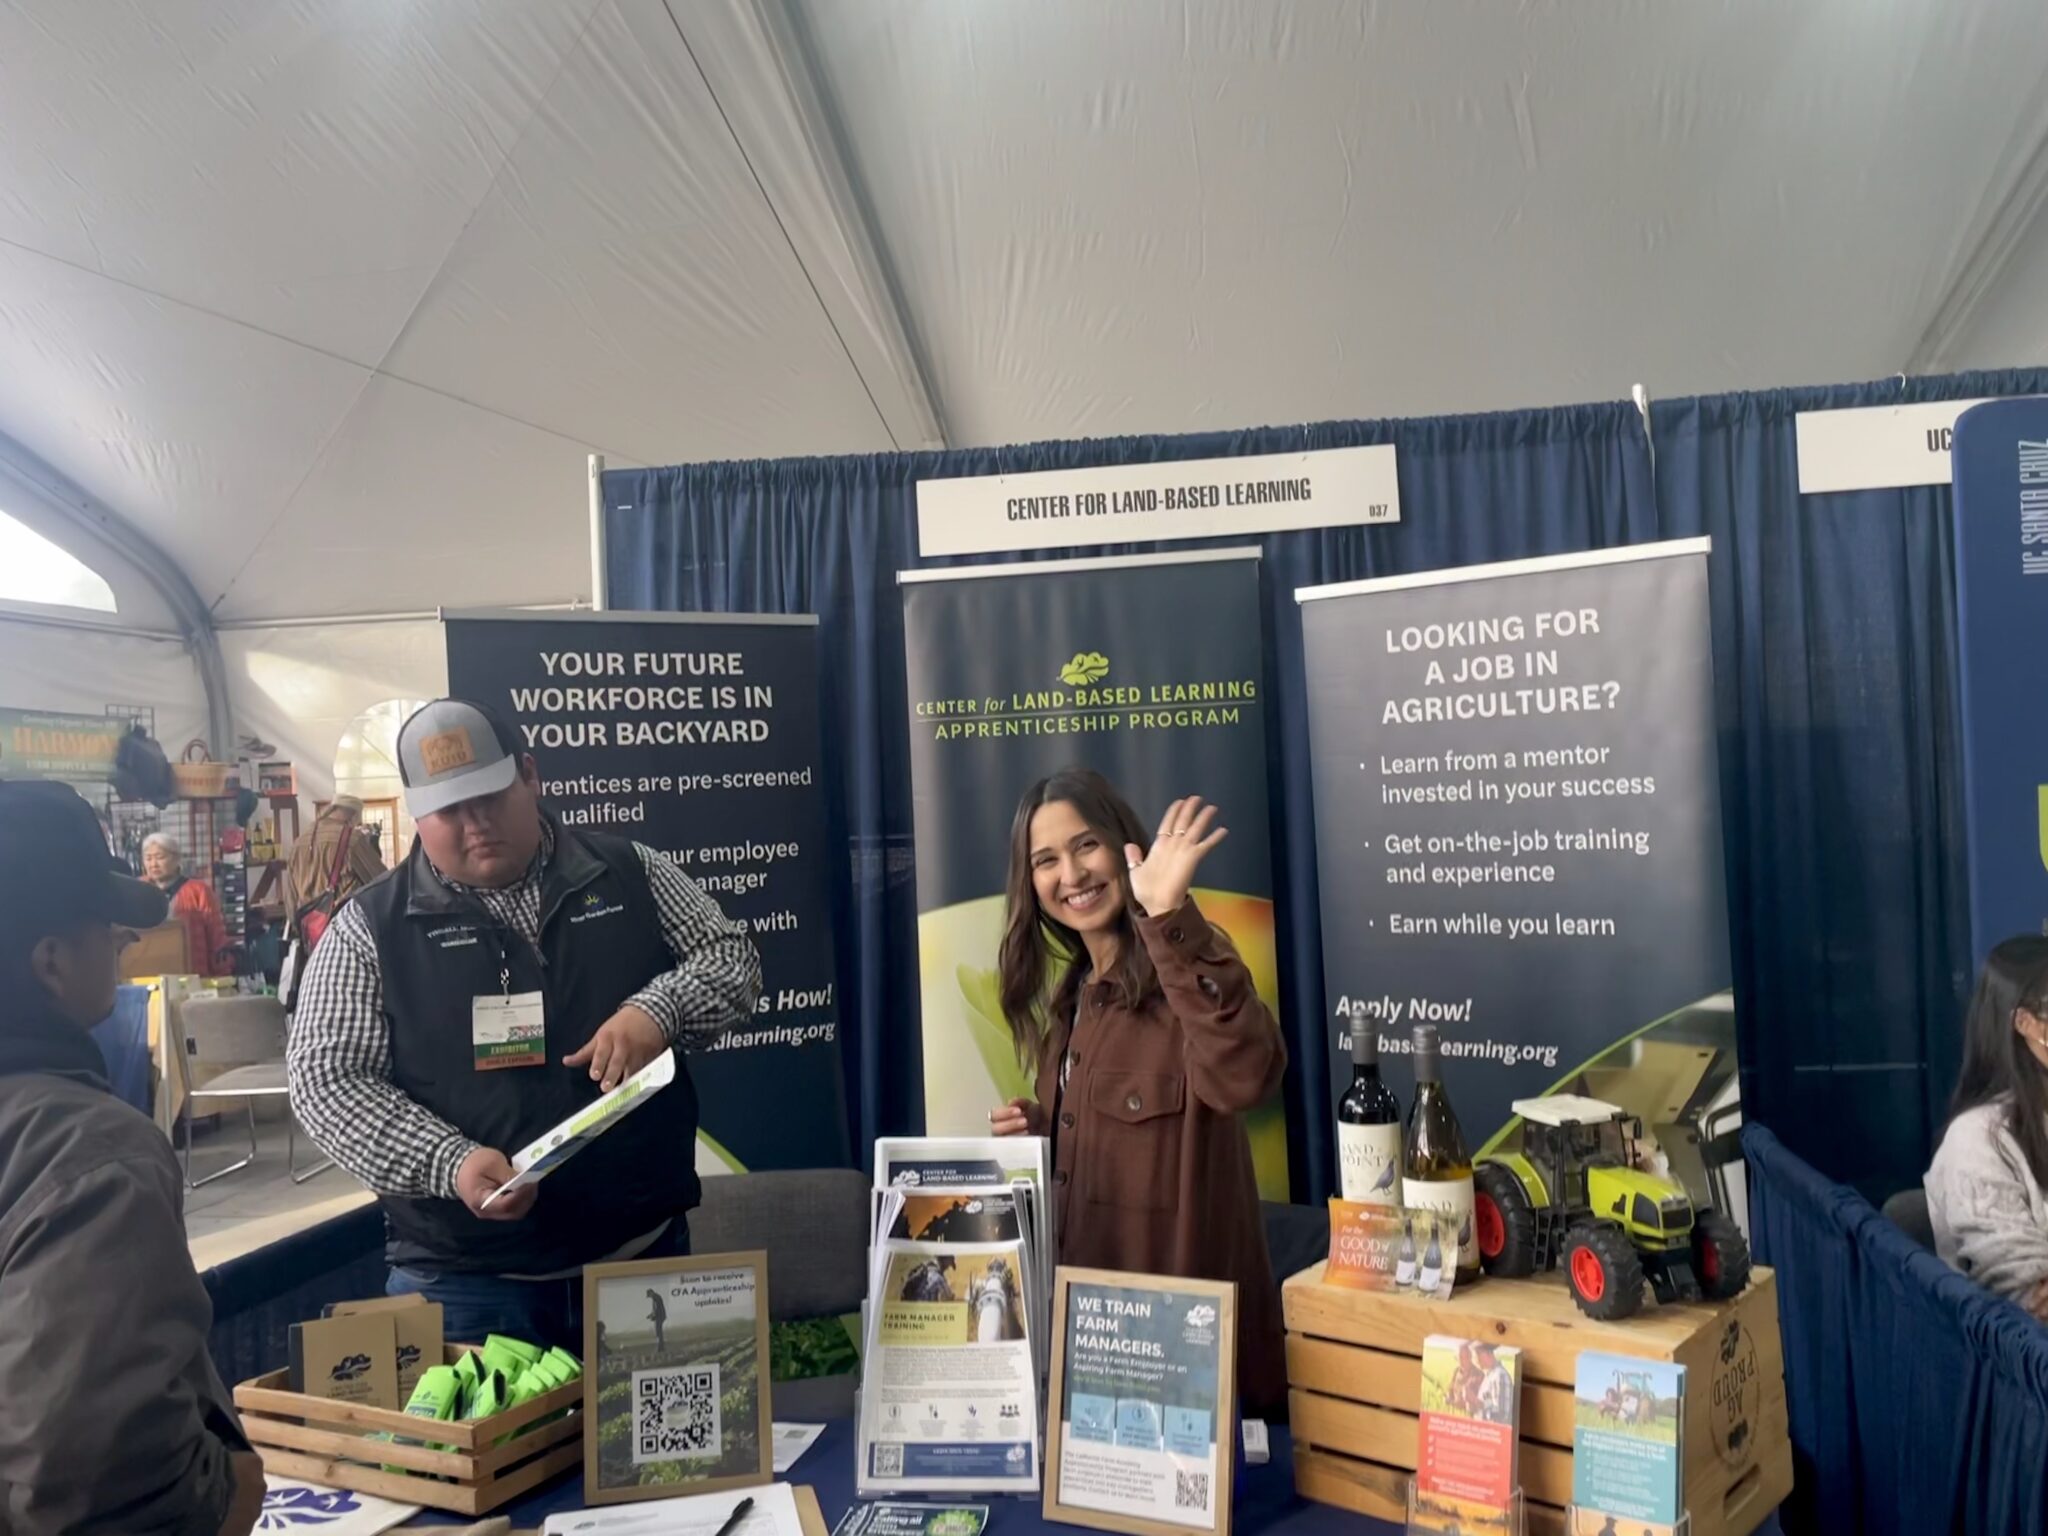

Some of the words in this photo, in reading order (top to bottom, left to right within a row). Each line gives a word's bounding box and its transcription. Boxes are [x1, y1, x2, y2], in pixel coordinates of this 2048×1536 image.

[1927, 427, 1952, 452] UC
[1007, 495, 1070, 521] CENTER
[1075, 492, 1108, 517] FOR
[1112, 485, 1220, 515] LAND-BASED
[1226, 478, 1312, 506] LEARNING
[1386, 616, 1525, 653] LOOKING
[1535, 607, 1600, 638] FOR
[540, 652, 626, 677] YOUR
[634, 652, 744, 676] FUTURE
[1424, 661, 1446, 686] A
[1452, 654, 1515, 683] JOB
[1525, 650, 1558, 677] IN
[510, 686, 704, 712] WORKFORCE
[711, 686, 737, 709] IS
[745, 685, 774, 708] IN
[915, 698, 978, 716] CENTER
[984, 696, 1006, 715] for
[1012, 687, 1141, 711] LAND-BASED
[1150, 680, 1256, 704] LEARNING
[1382, 680, 1621, 725] AGRICULTURE?
[521, 722, 608, 748] YOUR
[616, 719, 770, 746] BACKYARD
[935, 713, 1120, 740] APPRENTICESHIP
[1129, 706, 1240, 731] PROGRAM
[1380, 754, 1439, 775] Learn
[1445, 749, 1500, 771] from
[1504, 752, 1517, 769] a
[1524, 744, 1611, 768] mentor
[541, 774, 632, 797] rentices
[638, 776, 672, 793] are
[678, 766, 812, 795] pre-screened
[1382, 779, 1472, 804] invested
[1478, 779, 1499, 801] in
[1504, 779, 1556, 804] your
[1561, 775, 1656, 797] success
[561, 801, 645, 825] ualified
[659, 845, 694, 866] our
[699, 840, 799, 866] employee
[1385, 833, 1423, 855] Get
[1427, 829, 1549, 857] on-the-job
[1554, 827, 1650, 856] training
[695, 871, 768, 895] anager
[1386, 861, 1426, 884] and
[1431, 861, 1556, 888] experience
[753, 910, 798, 933] with
[1389, 914, 1438, 934] Earn
[1443, 912, 1502, 934] while
[1508, 915, 1549, 940] you
[1556, 912, 1616, 936] learn
[777, 983, 833, 1012] How!
[1408, 997, 1473, 1022] Now!
[706, 1022, 836, 1052] dlearning.org
[1338, 1031, 1559, 1068] labasearning.org
[1339, 1235, 1381, 1253] GOOD
[1338, 1252, 1390, 1271] NATURE
[1077, 1296, 1102, 1313] WE
[1105, 1299, 1151, 1318] TRAIN
[1076, 1315, 1119, 1333] FARM
[1075, 1333, 1165, 1358] MANAGERS.
[1713, 1350, 1755, 1407] PROUD
